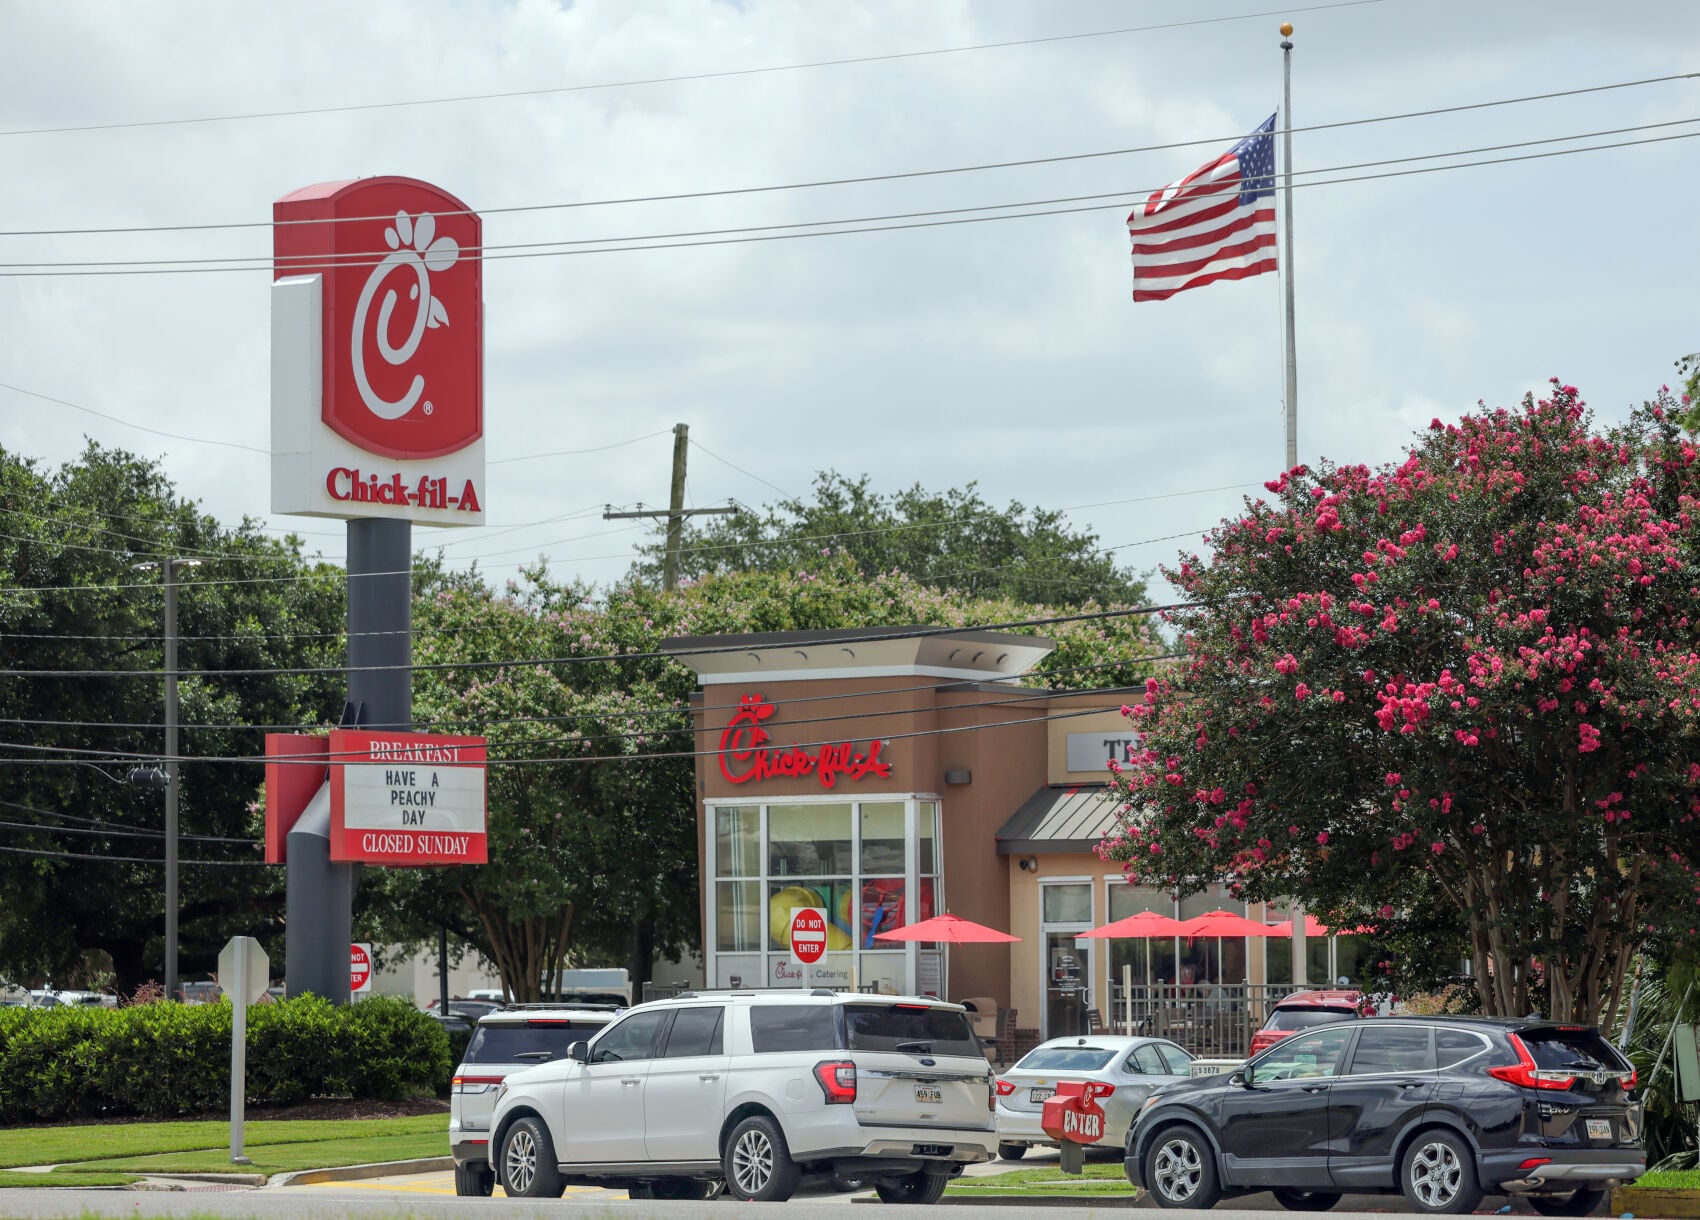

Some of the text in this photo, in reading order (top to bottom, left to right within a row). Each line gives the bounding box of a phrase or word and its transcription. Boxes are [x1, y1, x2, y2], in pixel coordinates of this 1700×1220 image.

[326, 467, 481, 513] Chick-fil-A
[718, 692, 892, 789] Chick-fil-A
[369, 741, 461, 762] BREAKFAST
[386, 770, 439, 787] HAVE A
[391, 790, 436, 806] PEACHY
[402, 810, 426, 825] DAY
[362, 833, 469, 855] CLOSED SUNDAY
[796, 919, 822, 929] DO NOT
[798, 944, 820, 953] ENTER
[351, 953, 365, 962] NOT
[351, 974, 363, 982] TER
[816, 969, 848, 980] Catering
[1064, 1109, 1100, 1137] ENTER
